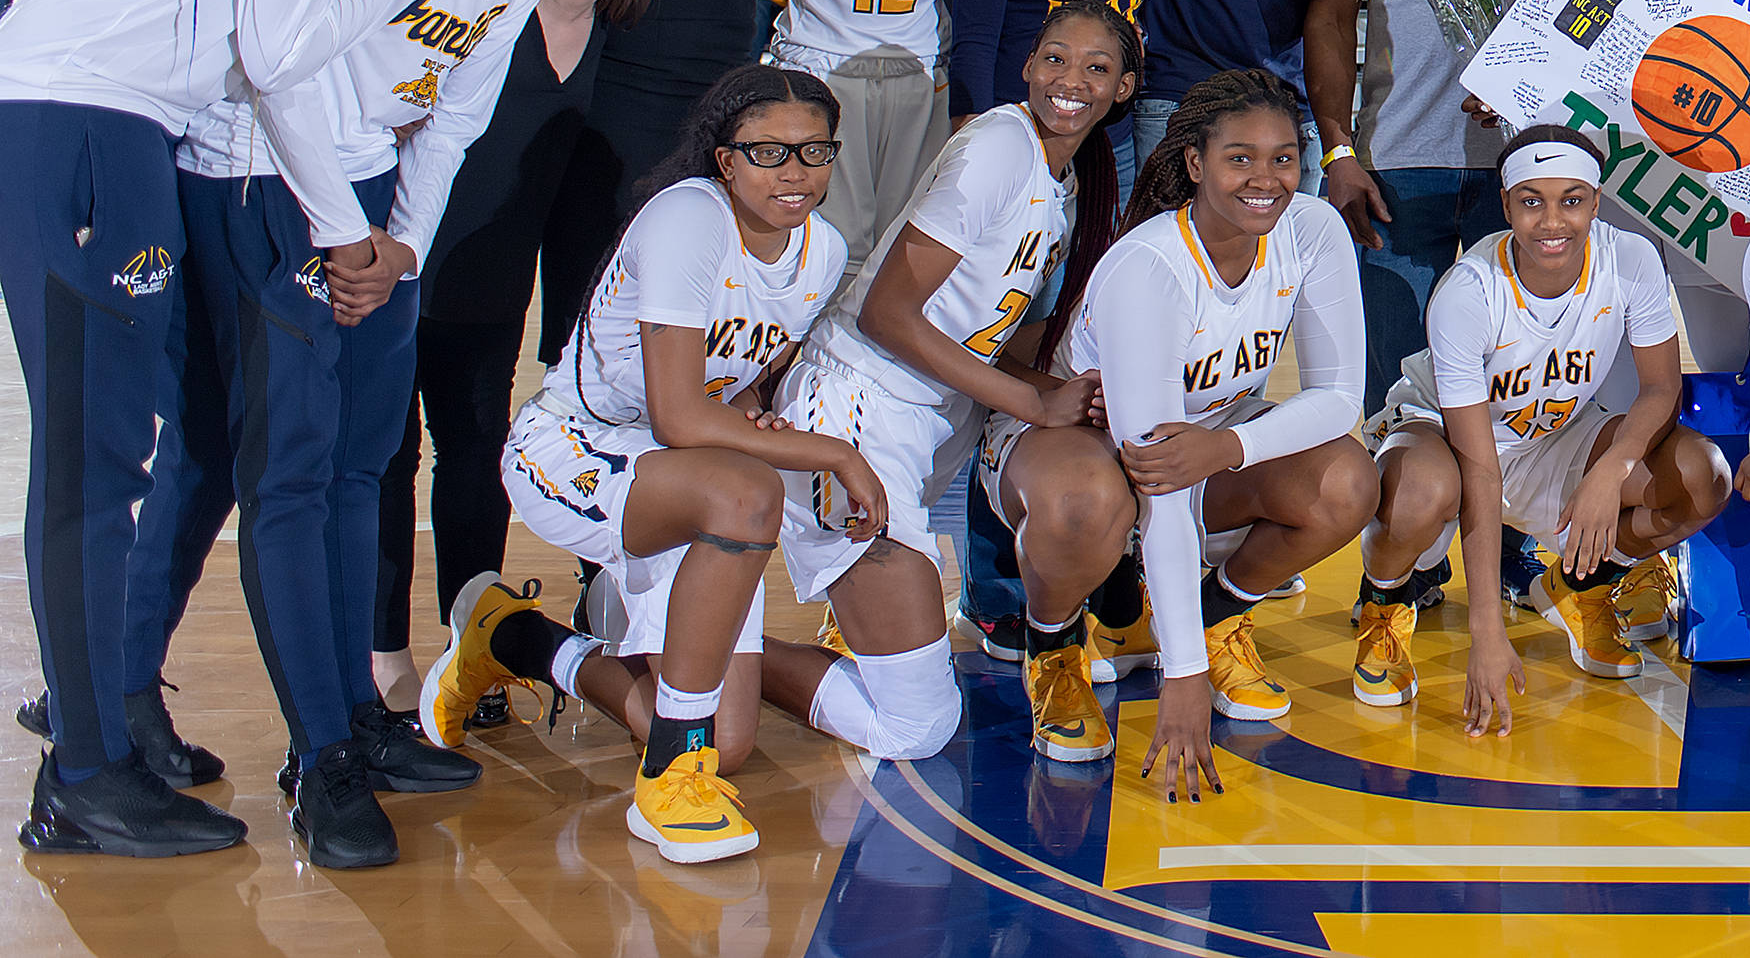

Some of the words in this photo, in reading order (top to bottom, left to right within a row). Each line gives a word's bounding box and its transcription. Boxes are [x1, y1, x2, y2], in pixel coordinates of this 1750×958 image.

[1568, 14, 1592, 39] 10
[1586, 5, 1612, 27] A&T
[1671, 82, 1723, 128] #10
[1562, 90, 1729, 265] TYLER
[112, 273, 142, 285] NC
[148, 265, 175, 283] A&T
[295, 273, 319, 287] NC
